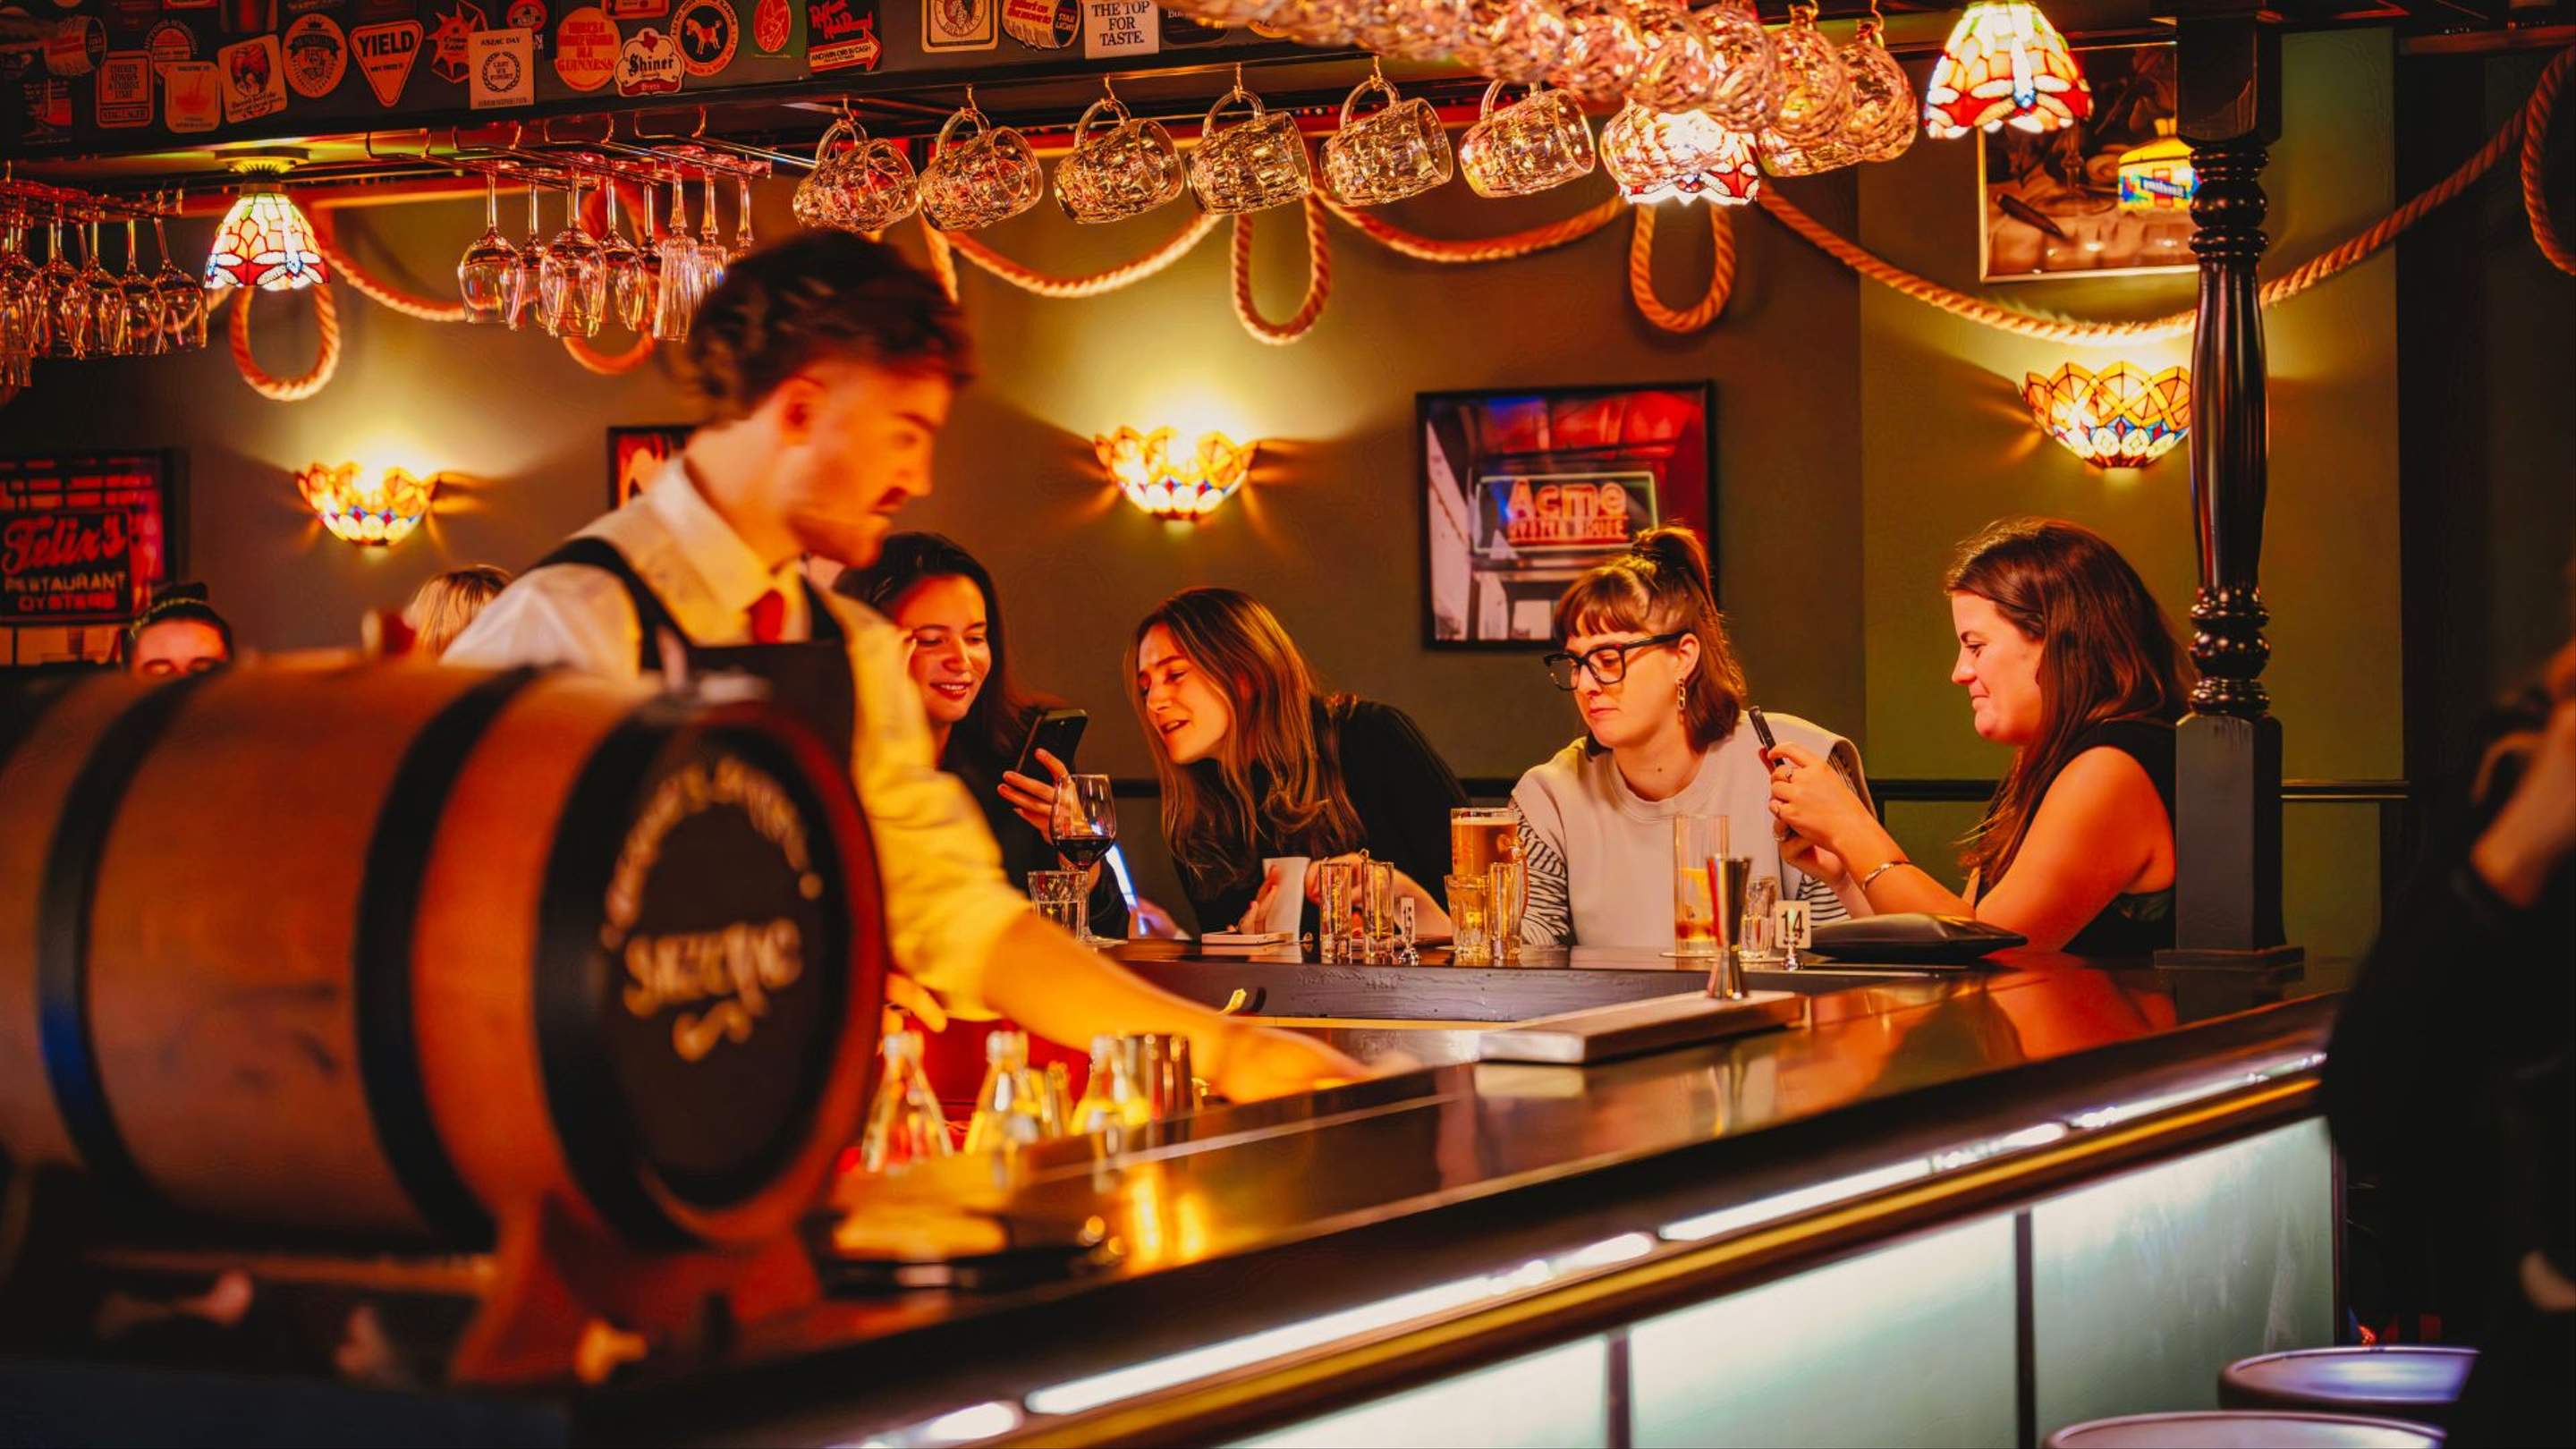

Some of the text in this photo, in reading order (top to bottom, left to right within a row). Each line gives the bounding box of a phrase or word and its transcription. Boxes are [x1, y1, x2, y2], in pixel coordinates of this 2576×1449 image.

[1091, 4, 1123, 17] THE
[1125, 0, 1150, 15] TOP
[1108, 16, 1136, 31] FOR
[358, 30, 414, 58] YIELD
[505, 36, 521, 44] DAY
[1099, 30, 1145, 47] TASTE.
[557, 57, 614, 72] GUINNESS
[629, 53, 674, 77] Shiner
[1508, 478, 1627, 519] Acme
[1781, 911, 1804, 939] 14
